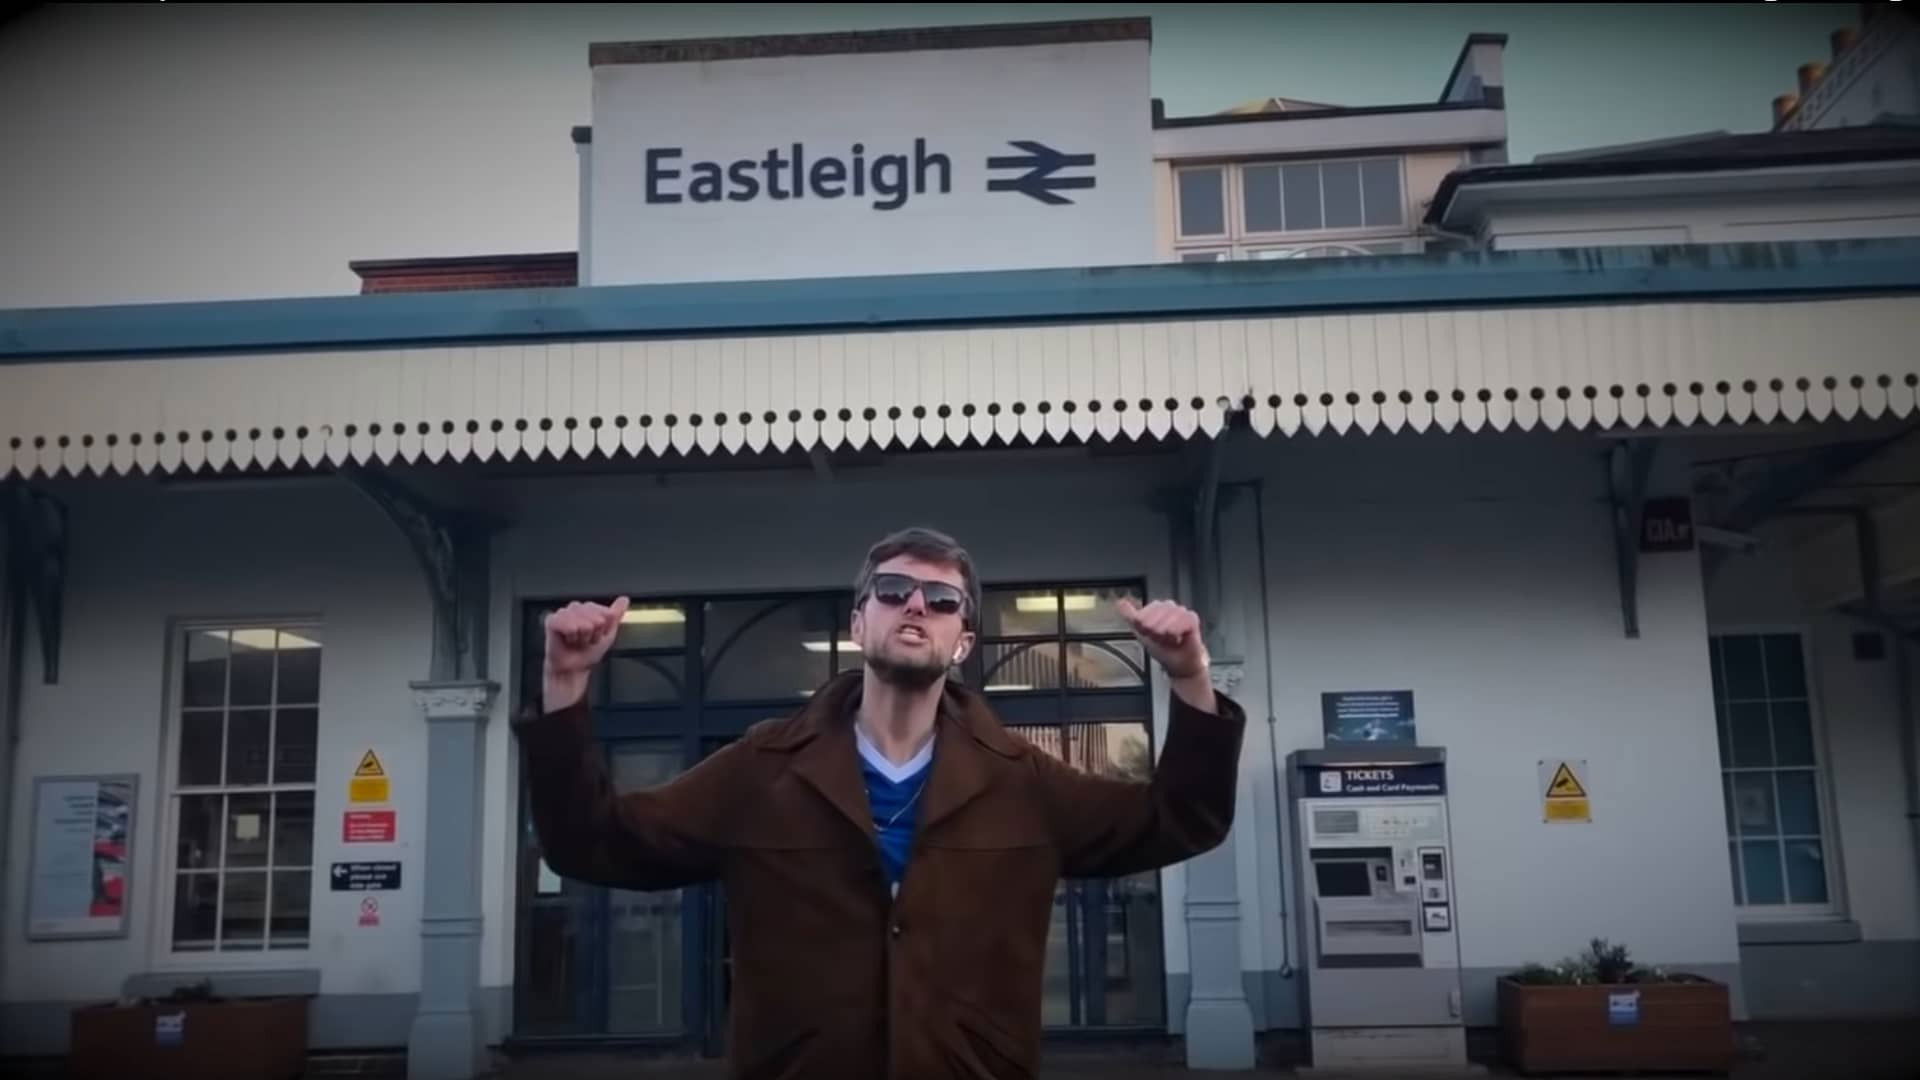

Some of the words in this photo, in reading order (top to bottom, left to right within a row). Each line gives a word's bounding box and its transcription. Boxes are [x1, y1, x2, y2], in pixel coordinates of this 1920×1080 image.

[645, 138, 951, 210] Eastleigh
[1345, 770, 1394, 781] TICKETS
[1382, 784, 1400, 792] Card
